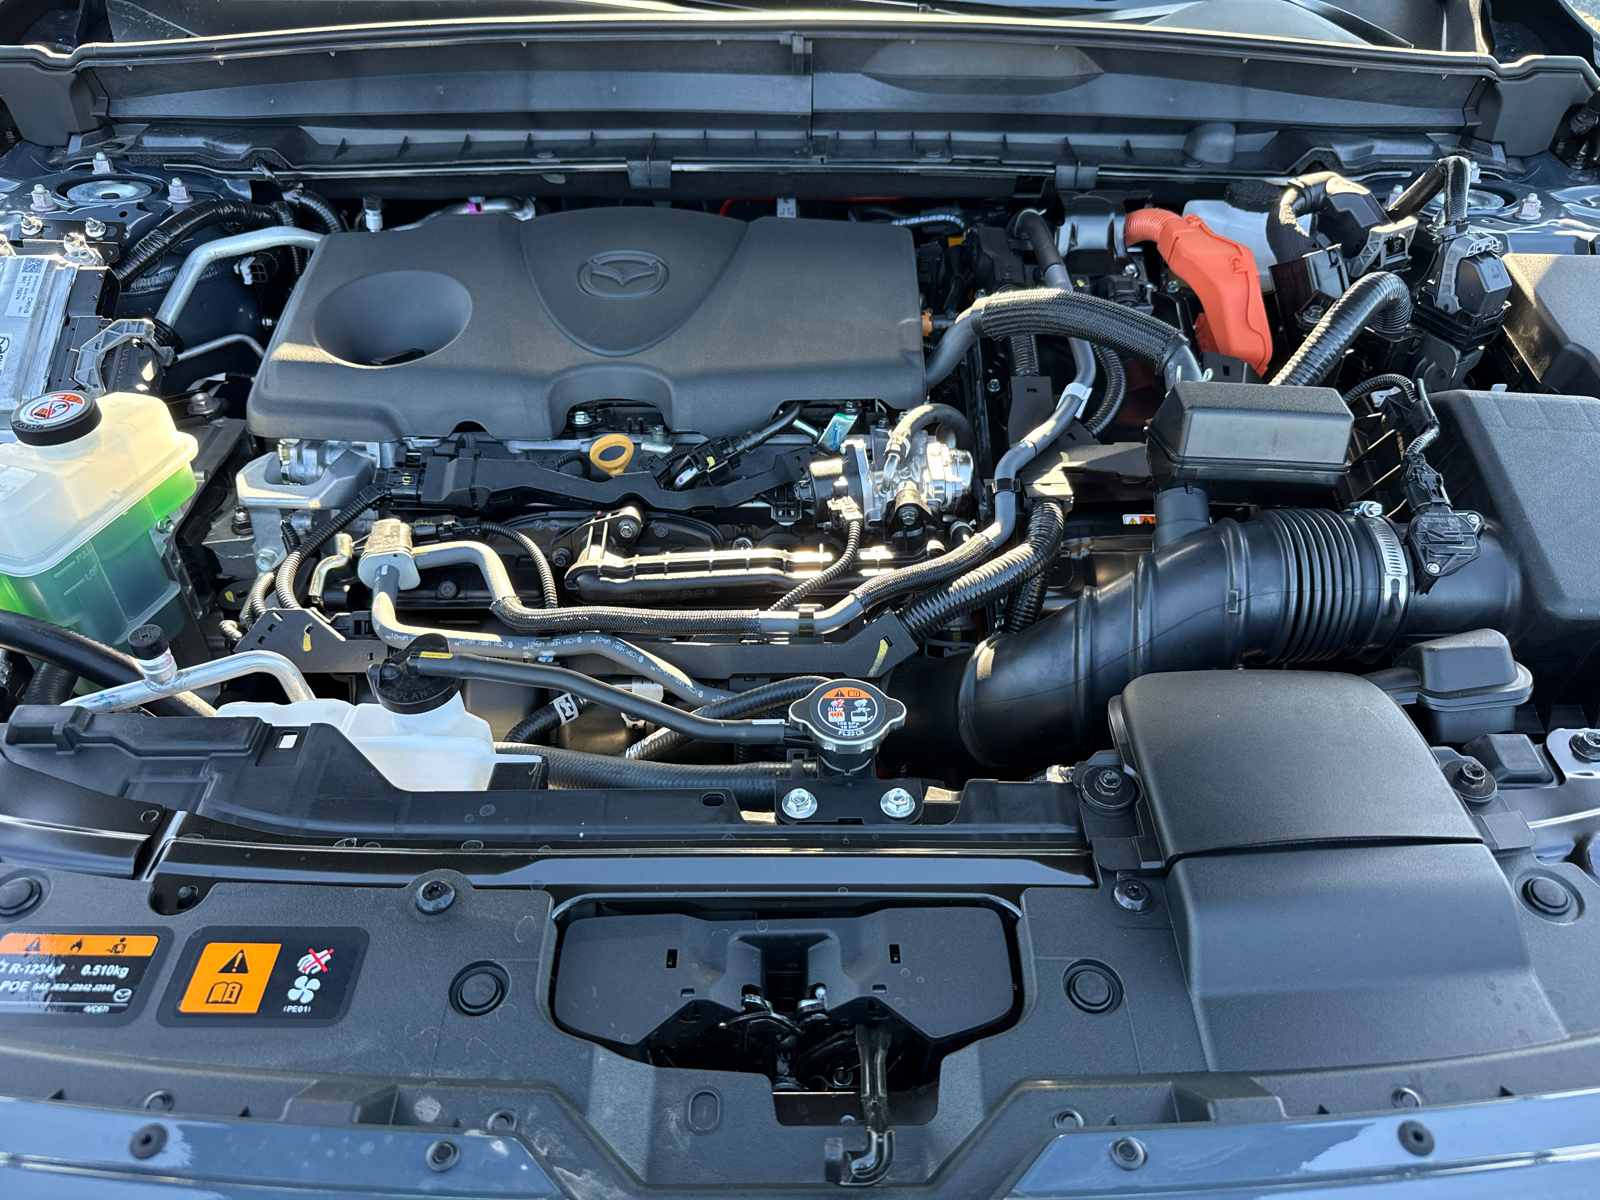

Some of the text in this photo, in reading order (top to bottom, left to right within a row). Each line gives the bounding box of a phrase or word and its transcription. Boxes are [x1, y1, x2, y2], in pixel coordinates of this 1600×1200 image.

[76, 546, 93, 563] FULL
[382, 686, 437, 701] COOLANT
[9, 963, 129, 979] R-1234yf 0.510kg
[0, 980, 31, 992] POE
[32, 983, 51, 991] SAE
